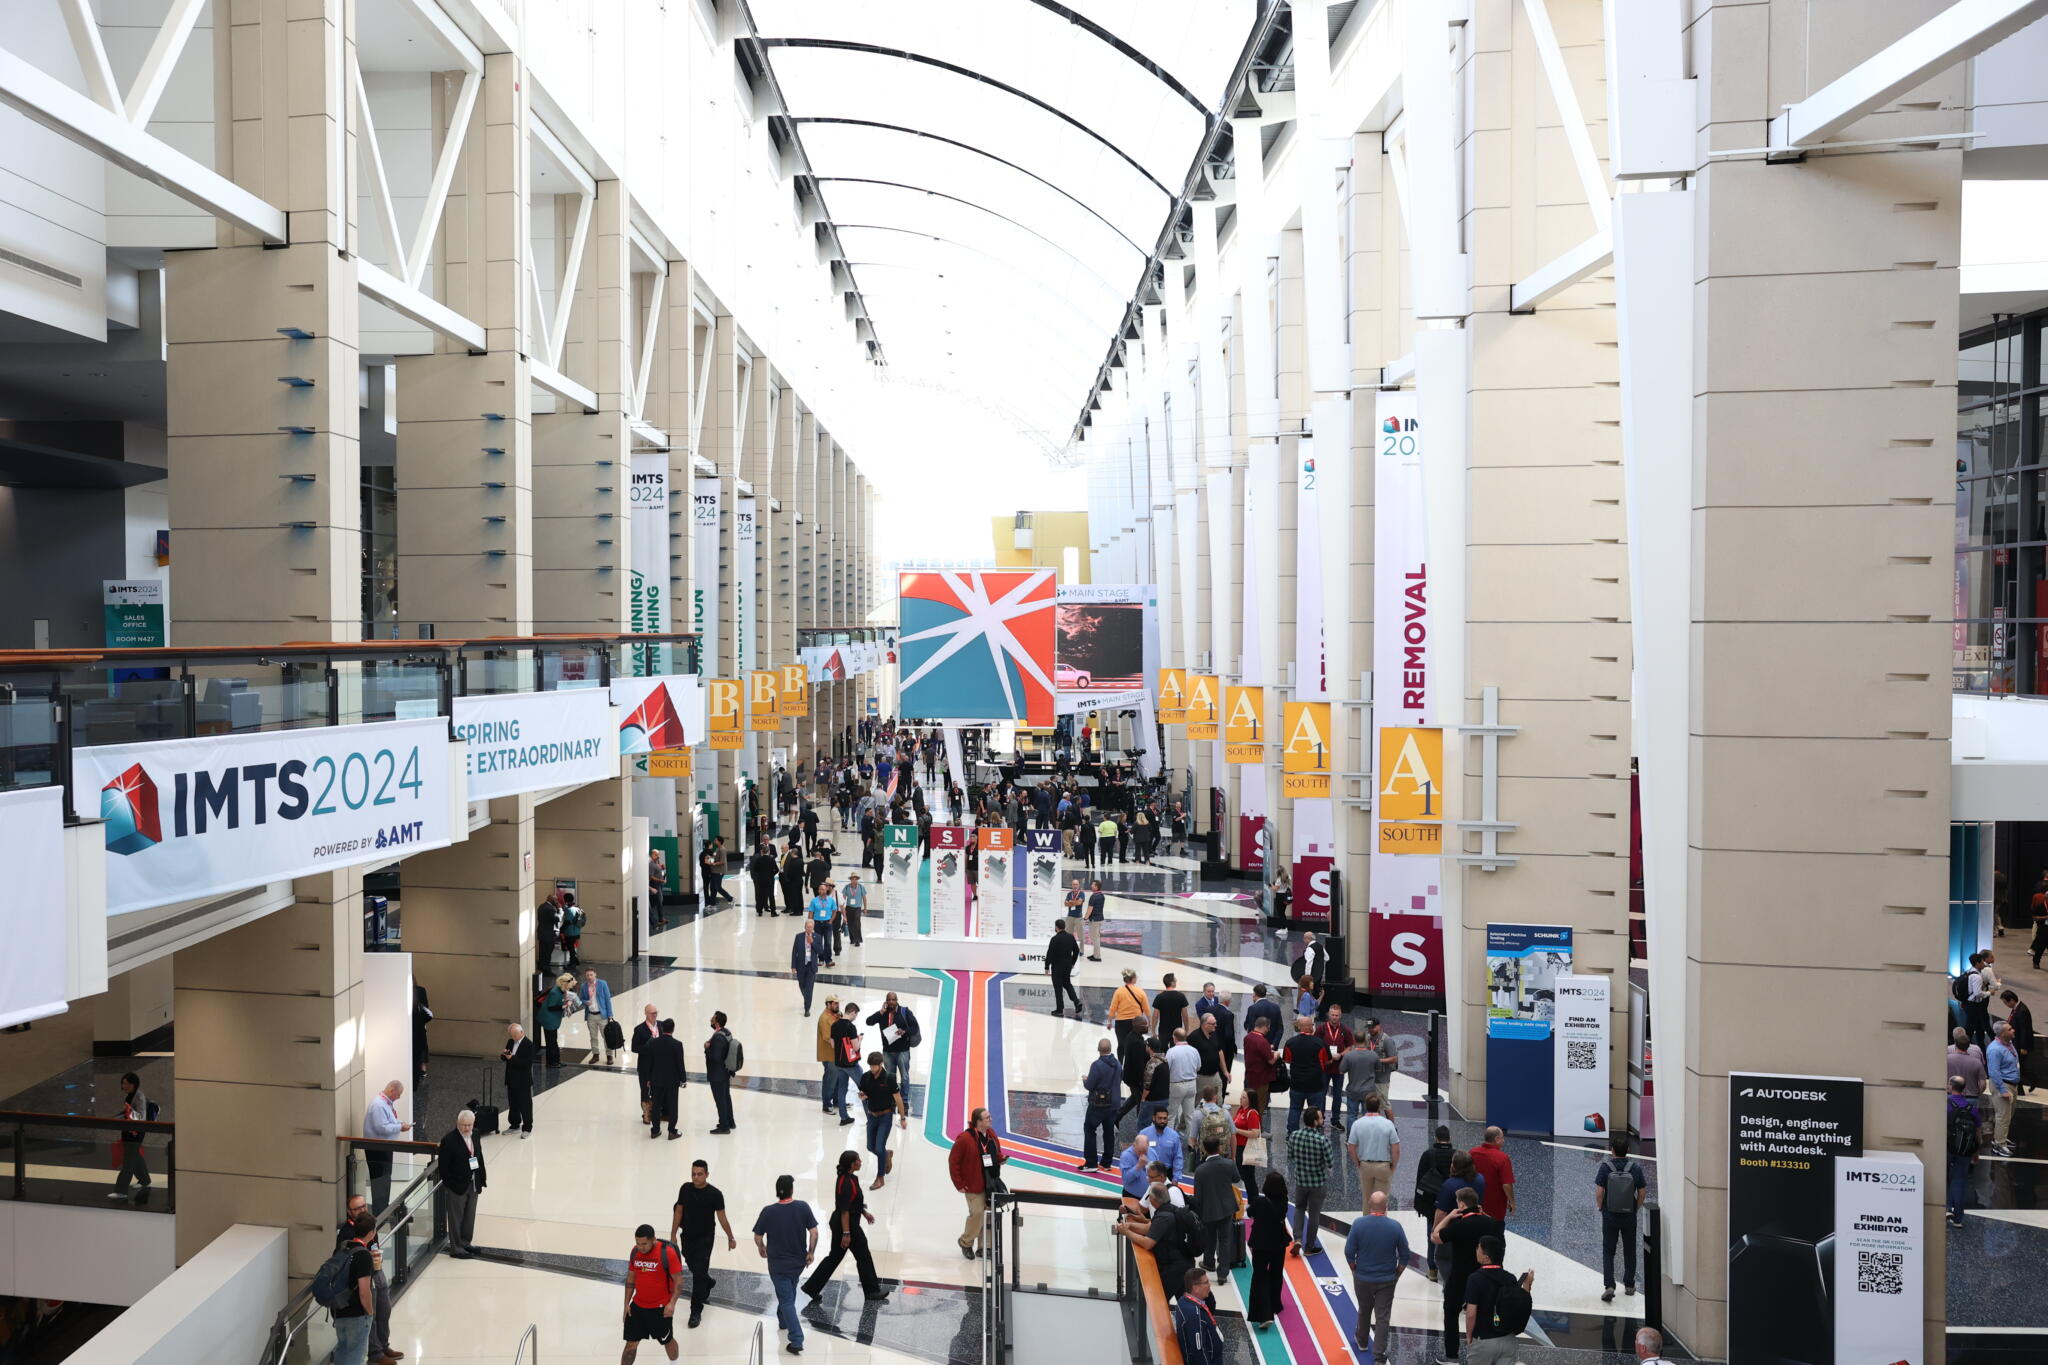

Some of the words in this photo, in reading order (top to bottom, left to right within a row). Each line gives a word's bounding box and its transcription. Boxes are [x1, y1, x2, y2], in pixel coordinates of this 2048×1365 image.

[1383, 436, 1421, 456] 20
[632, 474, 664, 484] IMTS
[630, 486, 664, 502] 024
[694, 496, 716, 504] MTS
[694, 506, 716, 519] 24
[738, 514, 752, 522] TS
[738, 523, 752, 534] 24
[1068, 589, 1094, 597] MAIN
[1098, 588, 1129, 598] STAGE
[1404, 563, 1426, 709] REMOVAL
[1122, 692, 1145, 700] STAGE
[453, 720, 520, 745] SPIRING
[1188, 726, 1218, 734] SOUTH
[711, 735, 743, 743] NORTH
[477, 738, 601, 774] EXTRAORDINARY
[1228, 747, 1262, 756] SOUTH
[650, 758, 689, 769] NORTH
[1286, 778, 1329, 788] SOUTH
[174, 745, 424, 838] IMTS2024
[313, 840, 358, 858] POWERED
[360, 837, 372, 849] BY
[388, 821, 423, 847] AMT
[894, 828, 907, 842] N
[942, 830, 953, 843] S
[990, 831, 1002, 844] E
[1034, 833, 1054, 846] W
[1382, 828, 1439, 842] SOUTH
[1309, 870, 1330, 906] S
[1388, 932, 1428, 976] S
[1560, 988, 1604, 996] IMTS2024
[1756, 1088, 1827, 1101] AUTODESK
[1740, 1115, 1784, 1128] Design,
[1786, 1118, 1839, 1130] engineer
[1740, 1129, 1761, 1138] and
[1765, 1130, 1796, 1140] make
[1799, 1133, 1852, 1146] anything
[1740, 1142, 1766, 1152] with
[1768, 1143, 1827, 1156] Autodesk.
[1740, 1158, 1768, 1167] Booth
[1770, 1160, 1810, 1170] #133310
[1846, 1171, 1916, 1185] IMTS2024
[1854, 1223, 1908, 1234] EXHIBITOR
[634, 1260, 659, 1268] HOCKEY
